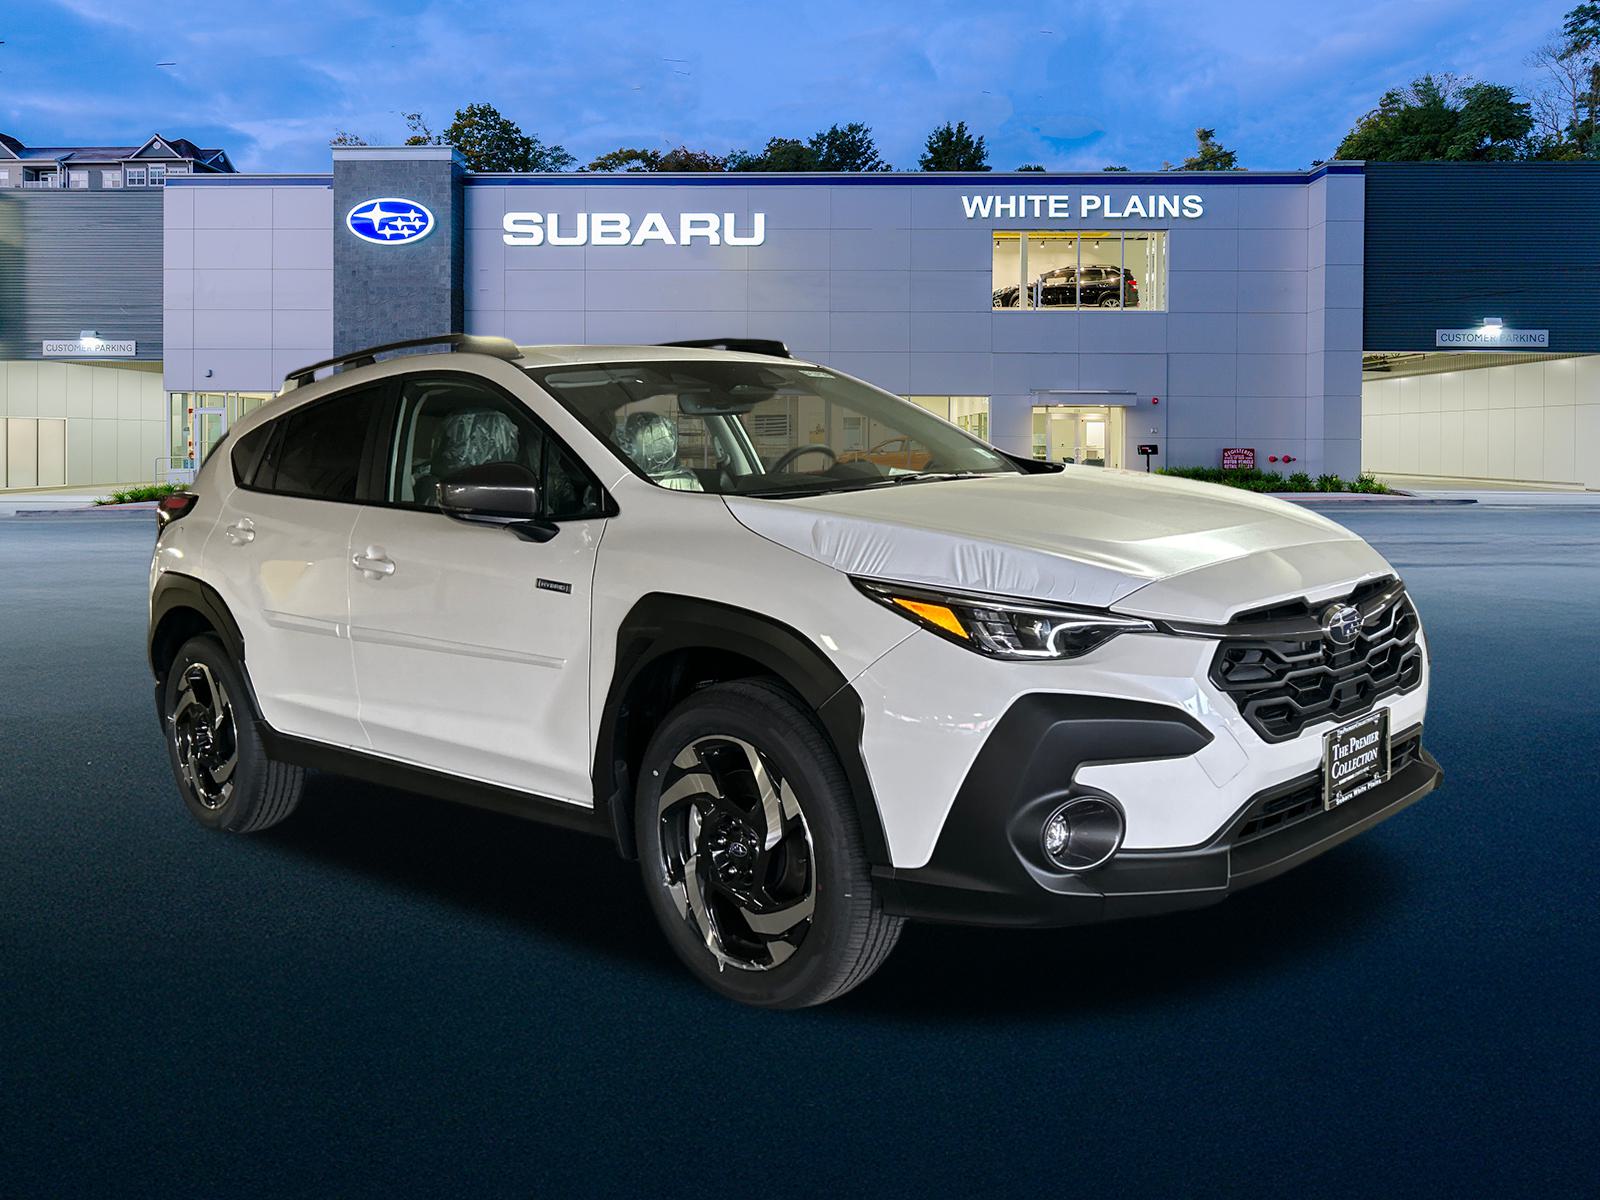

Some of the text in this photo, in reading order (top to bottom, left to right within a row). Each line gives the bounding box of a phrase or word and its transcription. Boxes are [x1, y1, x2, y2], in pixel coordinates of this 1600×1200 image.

[961, 195, 1204, 218] WHITE PLAINS
[502, 212, 766, 246] SUBARU
[46, 344, 133, 352] CUSTOMER PARKING
[1440, 333, 1545, 343] CUSTOMER PARKING
[1332, 731, 1379, 761] THE PREMIER
[1331, 747, 1379, 779] COLLECTION
